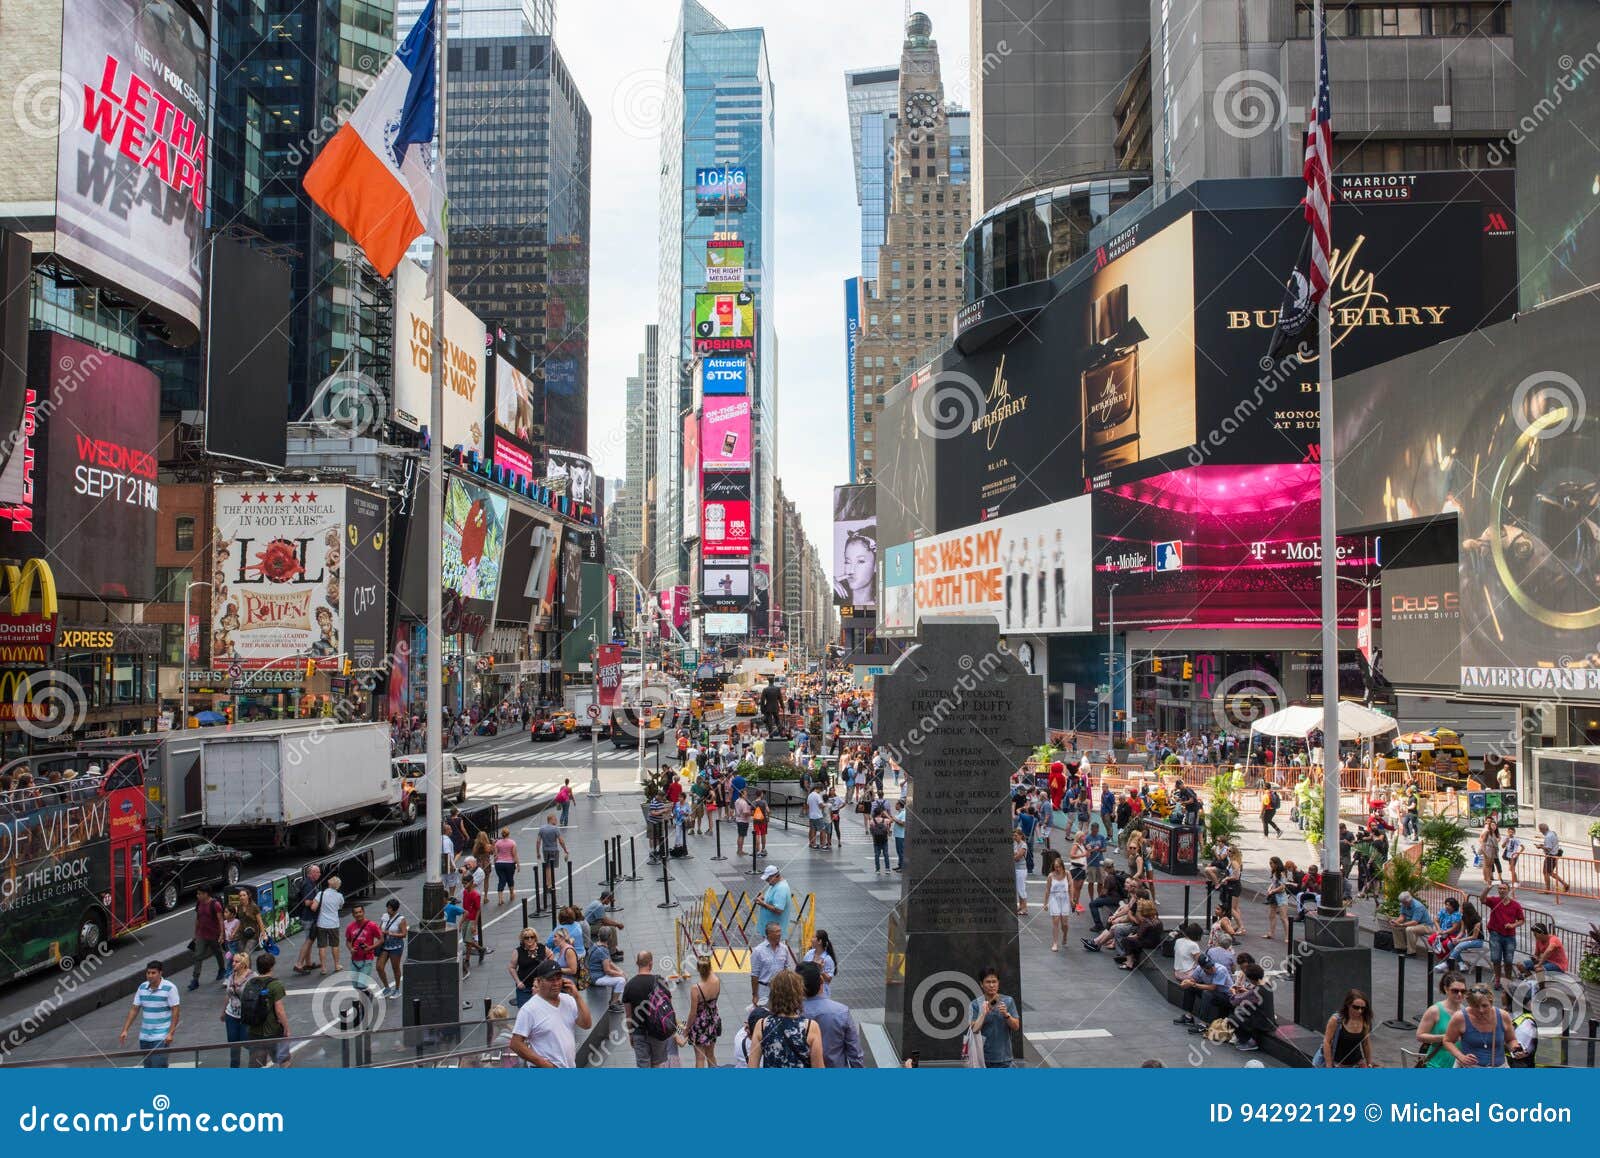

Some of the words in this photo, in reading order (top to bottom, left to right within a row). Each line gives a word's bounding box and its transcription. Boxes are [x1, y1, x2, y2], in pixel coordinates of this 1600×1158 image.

[134, 43, 164, 77] NEW
[163, 66, 184, 95] FOX
[698, 170, 745, 187] 10:56
[1342, 175, 1417, 187] MARRIOTT
[1342, 188, 1409, 200] MARQUIS
[707, 241, 744, 249] TOSHIBA
[713, 231, 738, 241] 2016
[1109, 223, 1140, 249] MARRIOTT
[1109, 237, 1137, 260] MARQUIS
[409, 312, 449, 362] YOR
[695, 338, 753, 350] TOSHIBA
[409, 338, 448, 387] YOR
[449, 365, 477, 403] WAY
[714, 370, 743, 380] TDK
[971, 396, 1028, 433] BURBERRY
[1273, 421, 1291, 429] AT
[74, 464, 126, 501] SEPT
[126, 477, 142, 506] 21
[223, 505, 241, 515] THE
[243, 505, 294, 514] FUNNIEST
[297, 504, 336, 514] MUSICAL
[239, 515, 252, 526] IN
[255, 516, 278, 526] 400
[939, 535, 974, 573] WAS
[976, 527, 1003, 566] MY
[965, 566, 1004, 603] TIME
[353, 584, 376, 617] CATS
[56, 630, 114, 648] XPRESS
[1463, 667, 1576, 690] AMERICAN
[38, 801, 107, 852] VIEW
[1, 875, 23, 897] OF
[26, 867, 52, 890] THE
[54, 857, 89, 882] ROCK
[55, 880, 89, 895] CENTER
